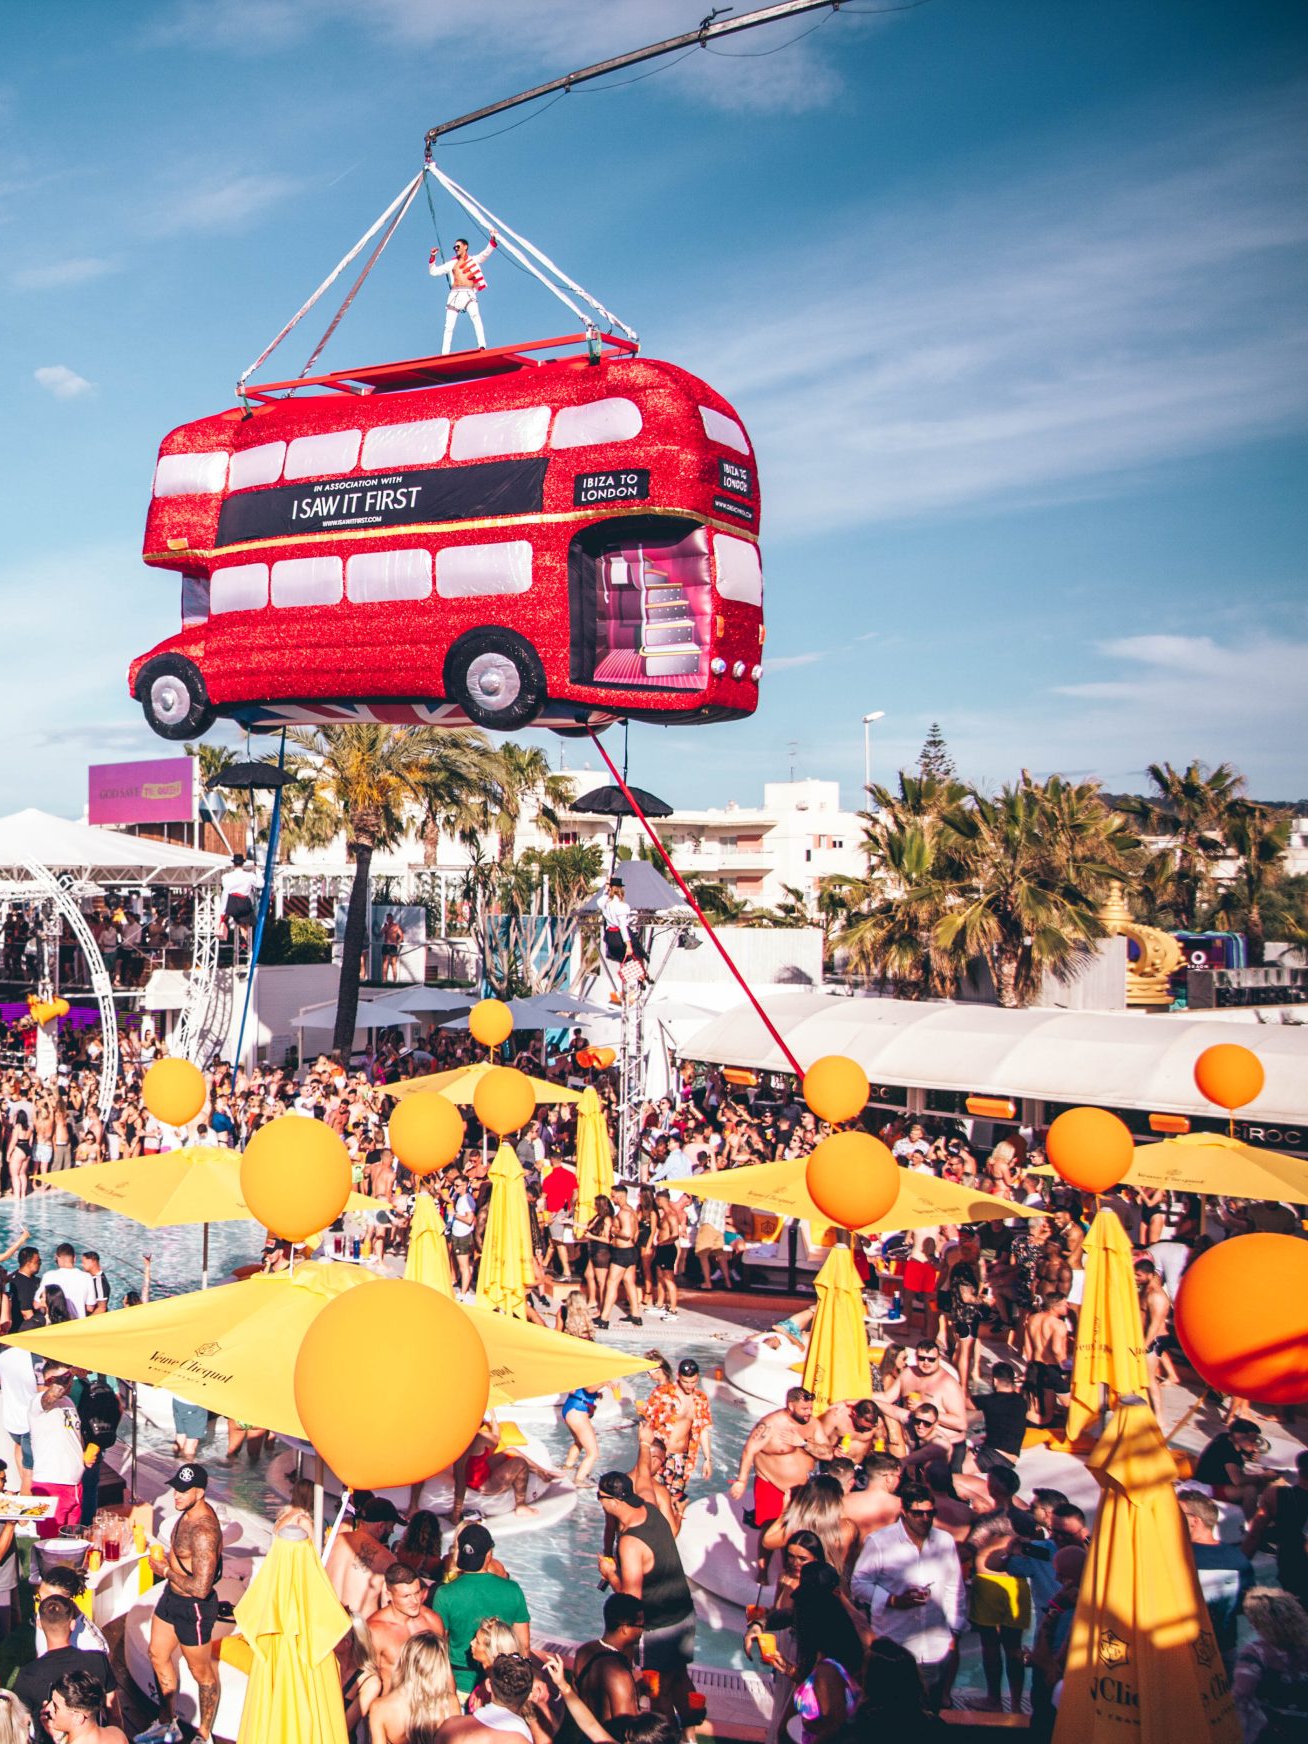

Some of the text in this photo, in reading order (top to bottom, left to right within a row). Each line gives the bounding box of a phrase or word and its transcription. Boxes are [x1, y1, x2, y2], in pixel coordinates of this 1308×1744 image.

[723, 463, 739, 477] IBIZA
[313, 476, 403, 493] IN ASSOCIATION WITH
[583, 474, 638, 489] IBIZA TO
[581, 486, 638, 502] LONDON
[292, 486, 422, 520] I SAW IT FIRST
[149, 1351, 179, 1367] Veuve
[179, 1359, 233, 1383] Clicquot
